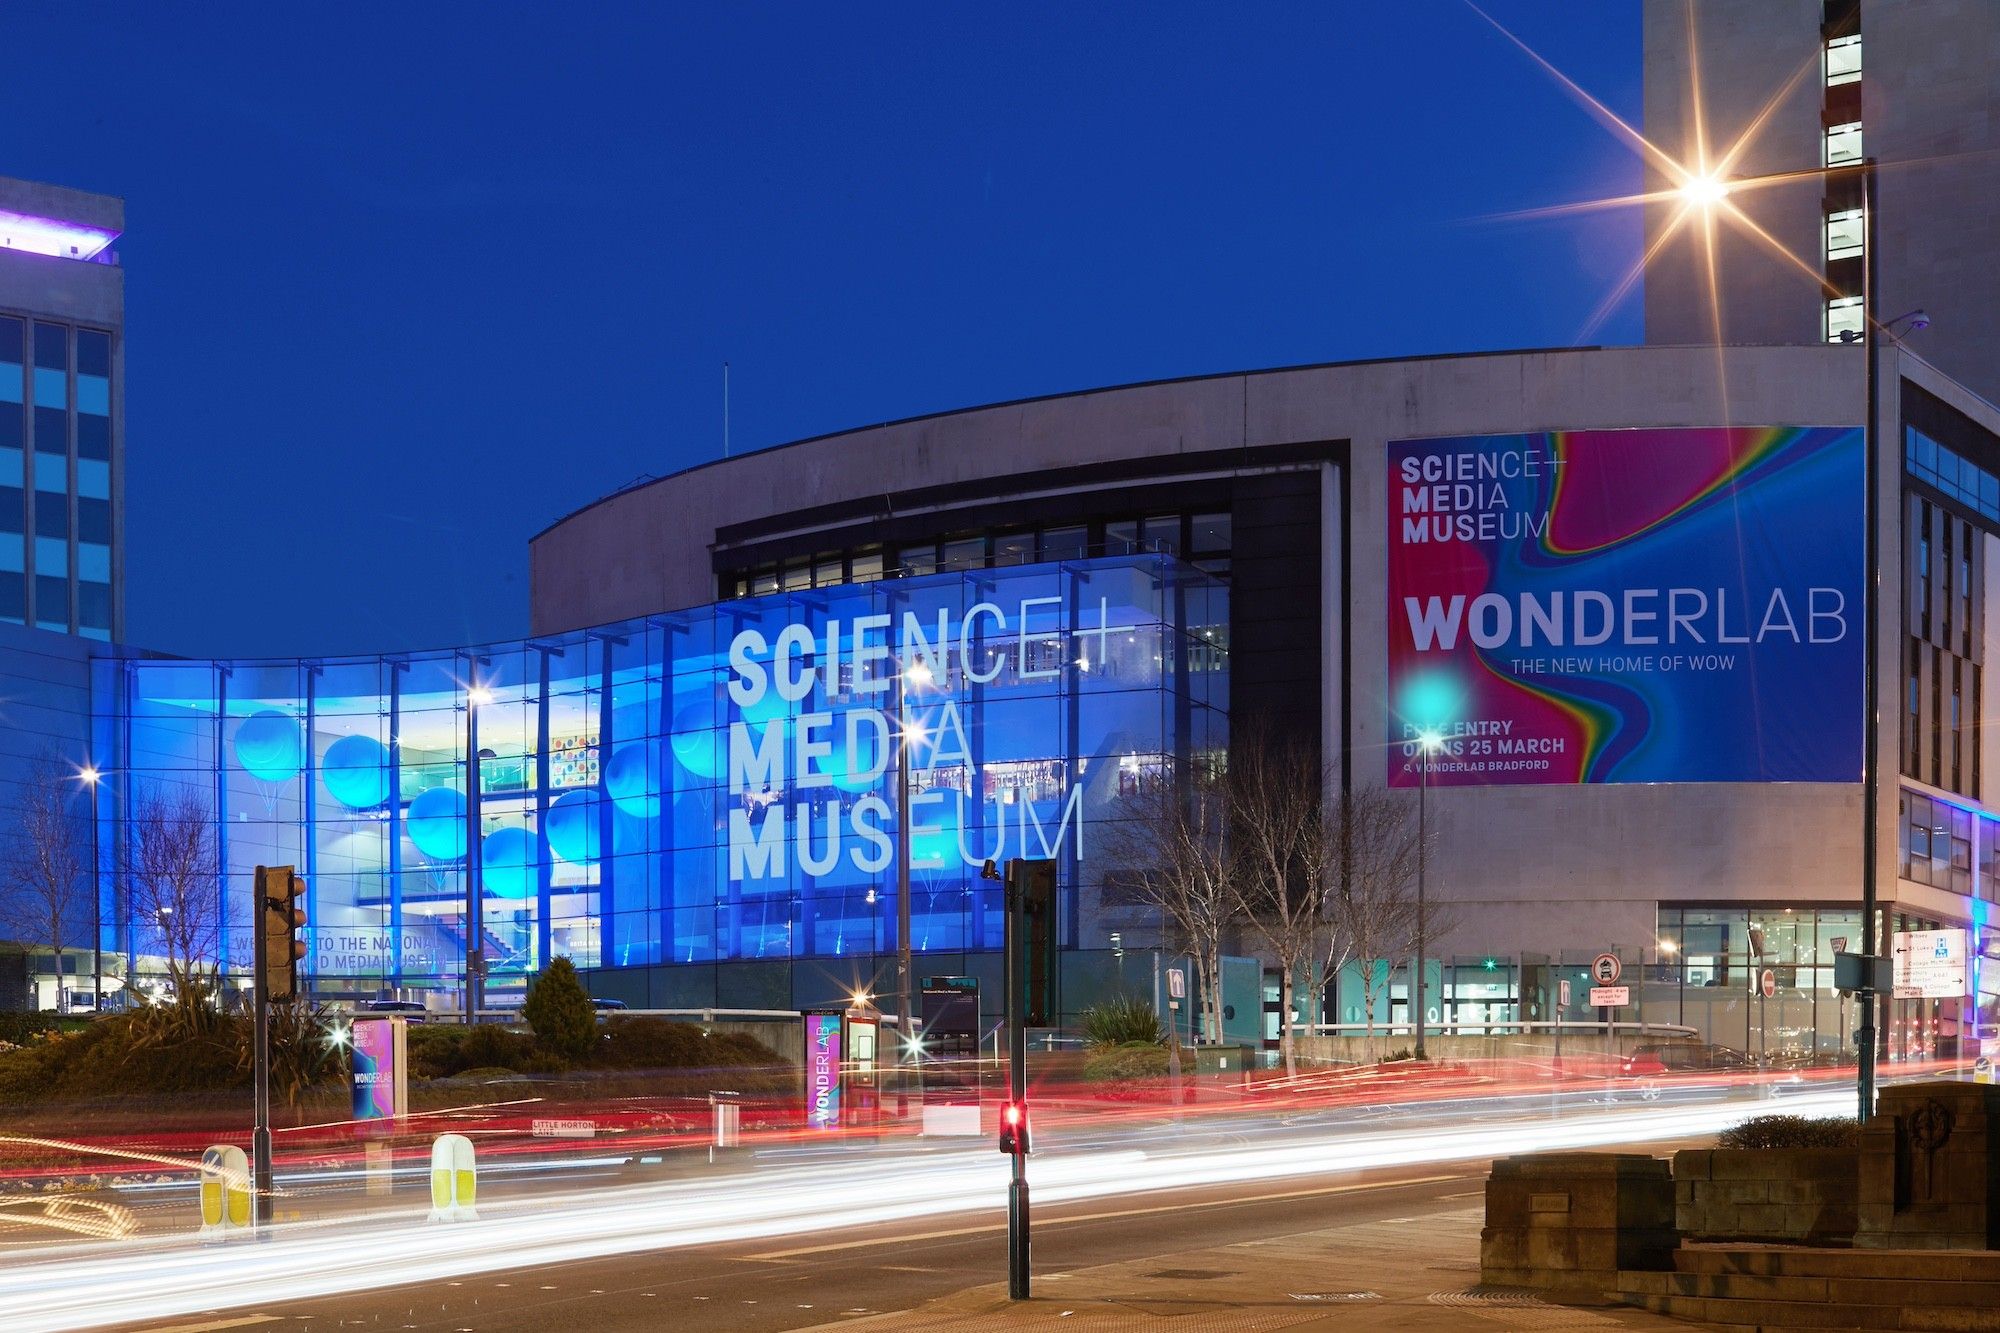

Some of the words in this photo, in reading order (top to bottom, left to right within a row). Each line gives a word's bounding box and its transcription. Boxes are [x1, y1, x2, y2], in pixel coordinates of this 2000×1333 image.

[1401, 450, 1567, 483] SCIENCE+
[1402, 482, 1509, 514] MEDIA
[1402, 511, 1550, 544] MUSEUM
[1404, 587, 1847, 651] WONDERLAB
[1511, 658, 1545, 674] THE
[1552, 657, 1594, 673] NEW
[1599, 656, 1653, 673] HOME
[1659, 655, 1683, 671] OF
[1688, 654, 1735, 671] WOW
[1455, 720, 1513, 737] ENTRY
[729, 700, 977, 796] MEDIA
[1470, 739, 1492, 755] 25
[1498, 738, 1564, 754] MARCH
[1488, 760, 1549, 771] BRADFORD
[728, 782, 1083, 881] MUSEUM
[318, 937, 334, 950] TO
[340, 937, 366, 950] THE
[335, 955, 381, 969] MEDIA
[354, 1072, 392, 1084] WONDERLAB
[816, 1026, 829, 1121] WONDERLAB
[561, 1121, 594, 1129] HORTON
